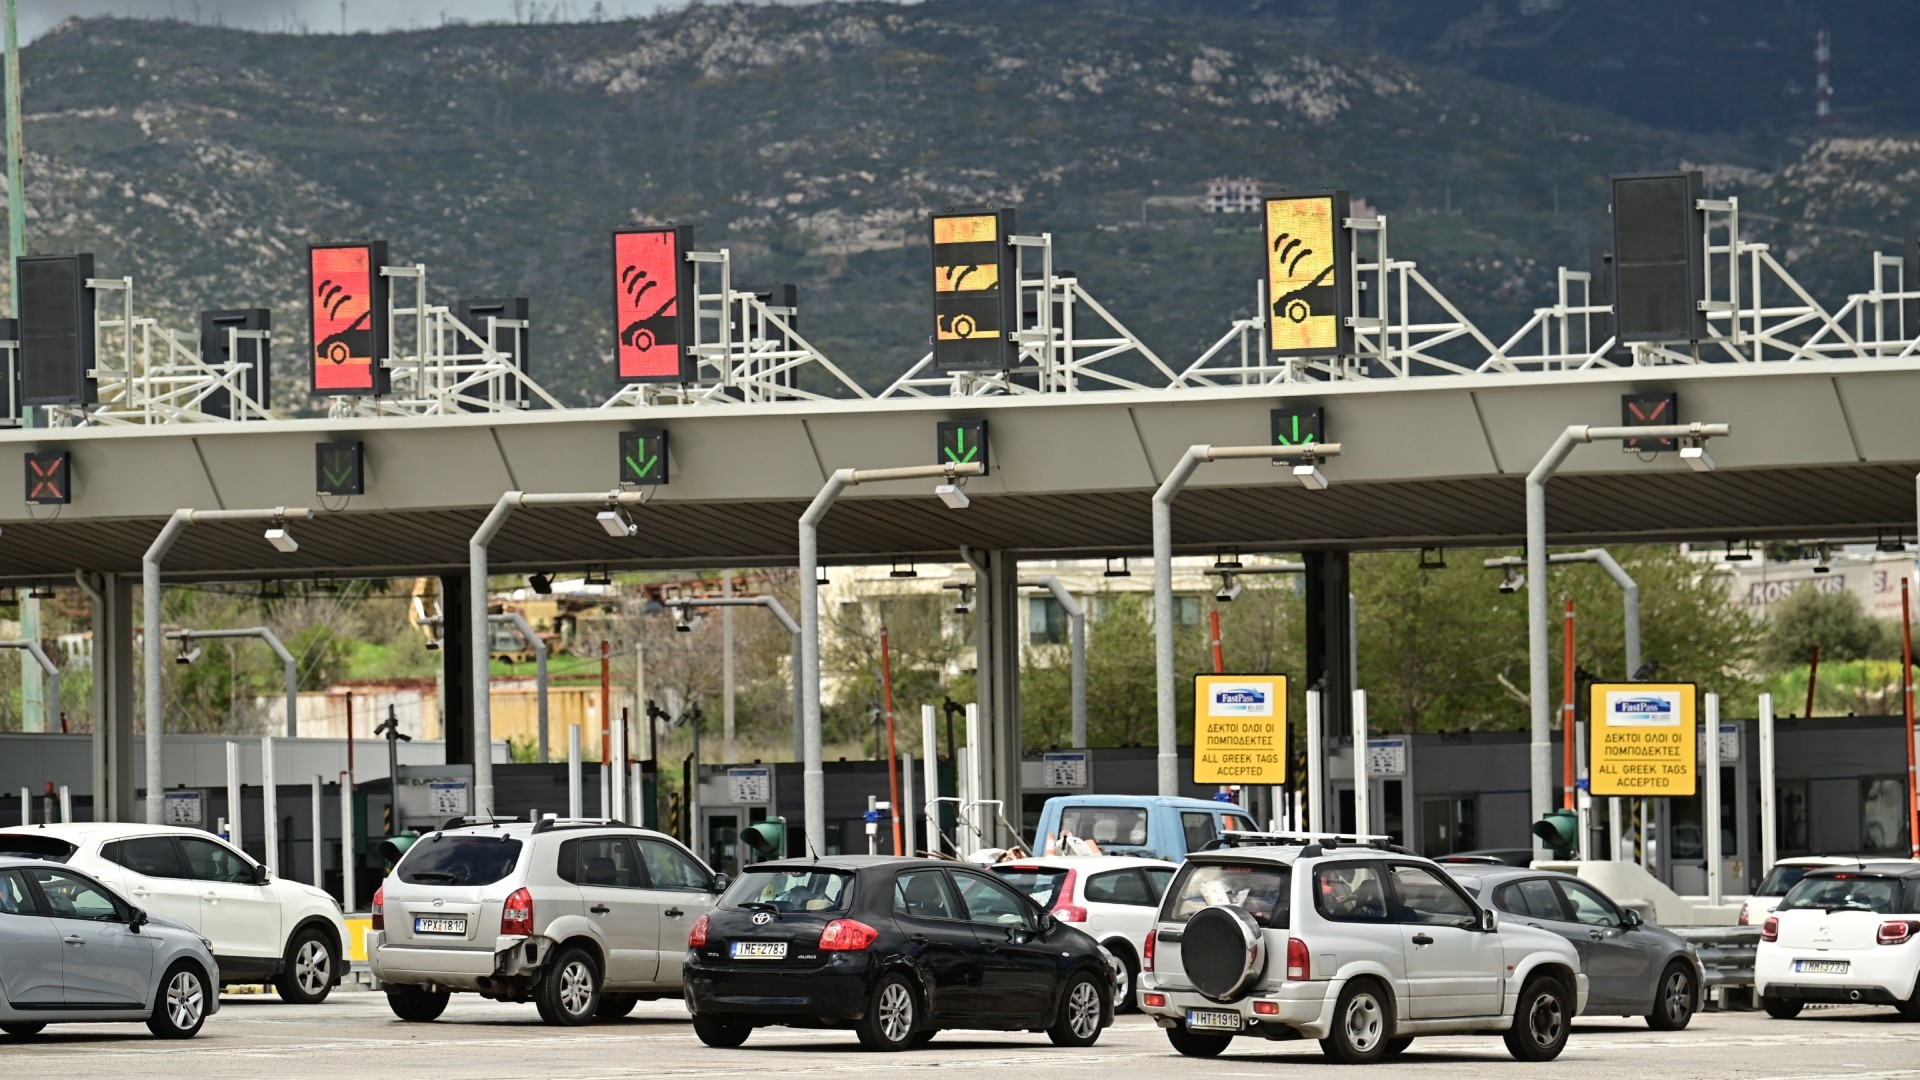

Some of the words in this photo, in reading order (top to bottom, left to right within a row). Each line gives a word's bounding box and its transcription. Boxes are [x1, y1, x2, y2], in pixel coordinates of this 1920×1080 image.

[1221, 693, 1254, 703] FastPass
[1622, 702, 1658, 712] FastPass
[1207, 724, 1239, 733] ΔΕΚΤΟΙ
[1242, 724, 1263, 733] ΟΛΟΙ
[1265, 724, 1274, 733] ΟΙ
[1207, 736, 1273, 746] ΠΟΜΠΟΔΕΚΤΕΣ
[1604, 733, 1640, 743] ΔΕΚΤΟΙ
[1645, 733, 1668, 743] ΟΛΟΙ
[1672, 733, 1682, 743] ΟΙ
[1604, 746, 1680, 756] ΠΟΜΠΟΔΕΚΤΕΣ
[1202, 754, 1218, 763] ALL
[1222, 754, 1252, 763] GREEK
[1256, 754, 1278, 763] TAGS
[1217, 767, 1263, 776] ACCEPTED
[1599, 765, 1618, 774] ALL
[1622, 765, 1656, 774] GREEK
[1662, 765, 1687, 774] TAGS
[1616, 778, 1670, 787] ACCEPTED
